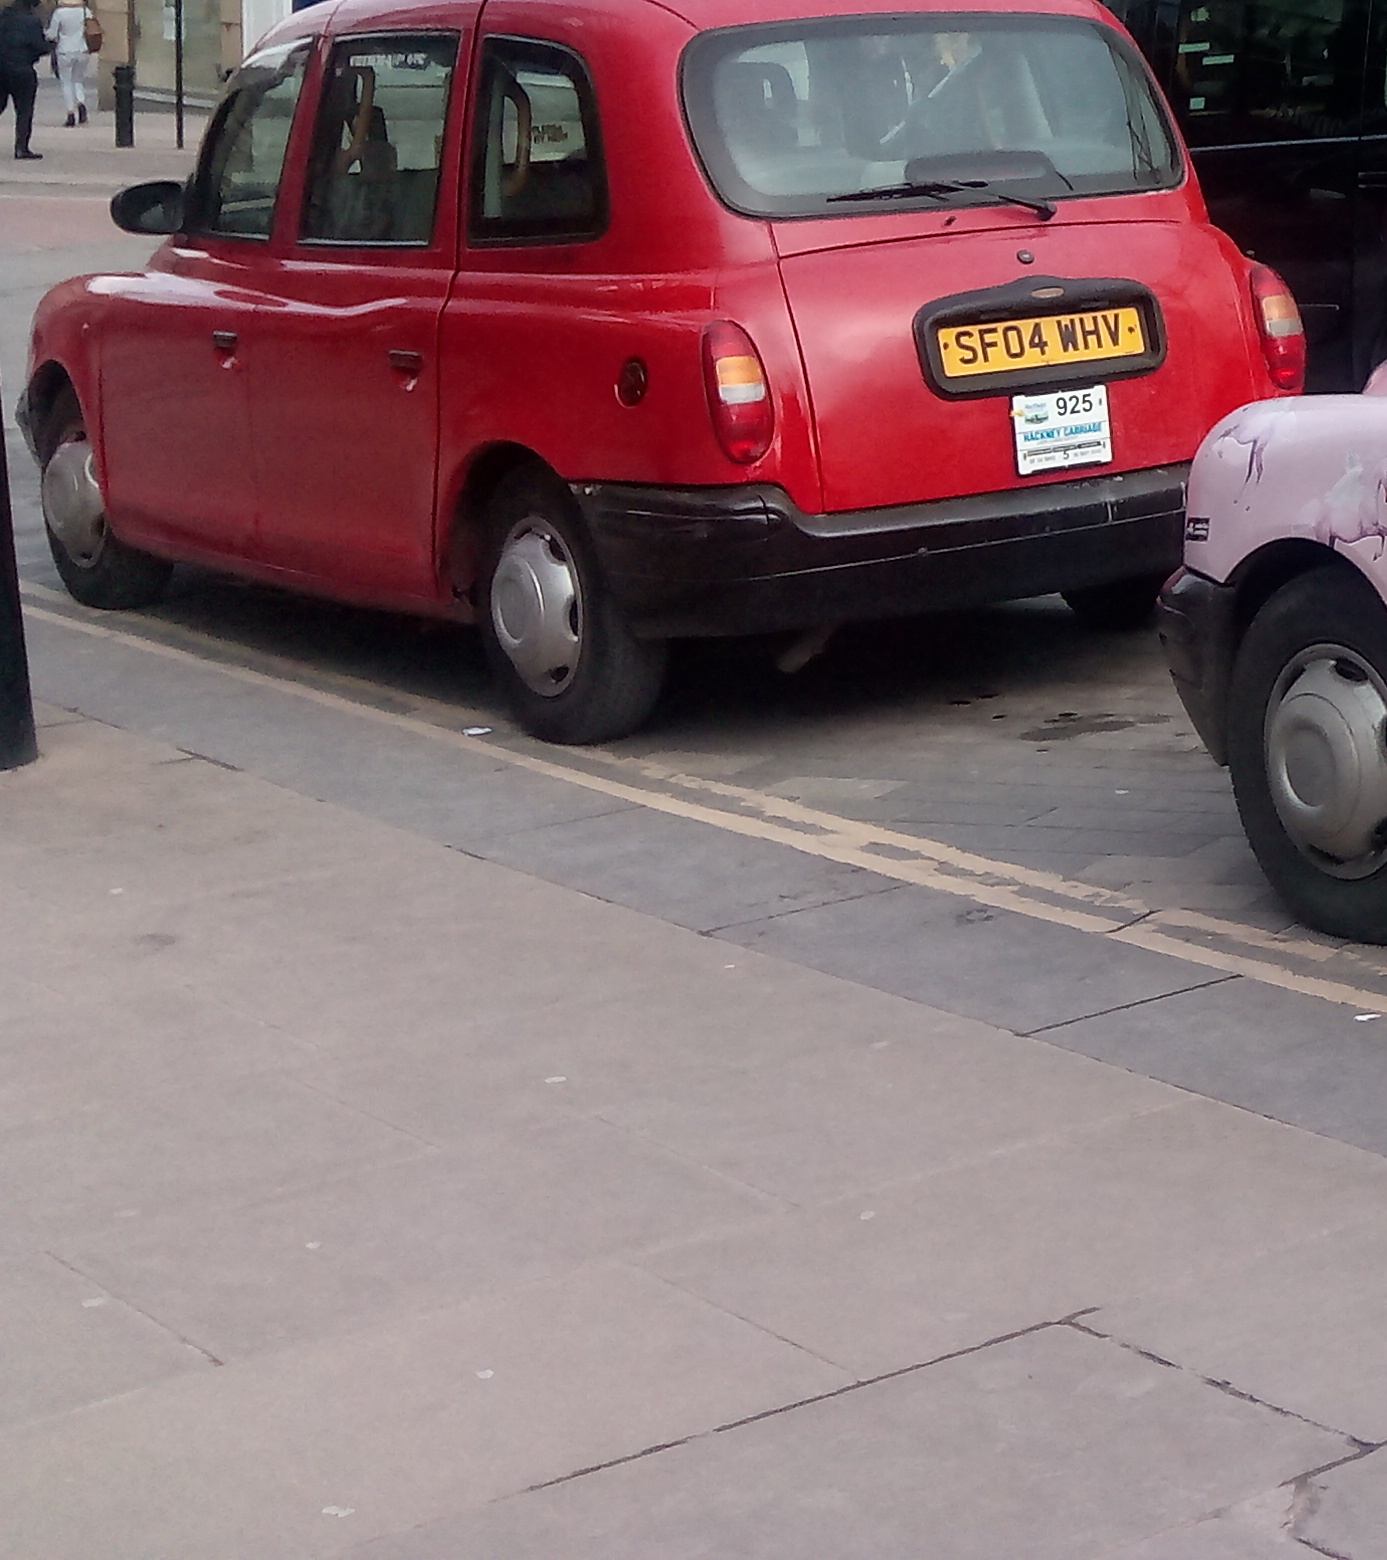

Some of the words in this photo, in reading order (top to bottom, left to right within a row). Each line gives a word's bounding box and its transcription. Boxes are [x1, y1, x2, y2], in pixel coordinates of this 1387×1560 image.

[954, 322, 1049, 365] SF04
[1055, 312, 1120, 354] WHV
[1056, 393, 1093, 416] 925
[1023, 429, 1060, 442] HACKNEY
[1063, 450, 1070, 460] 5
